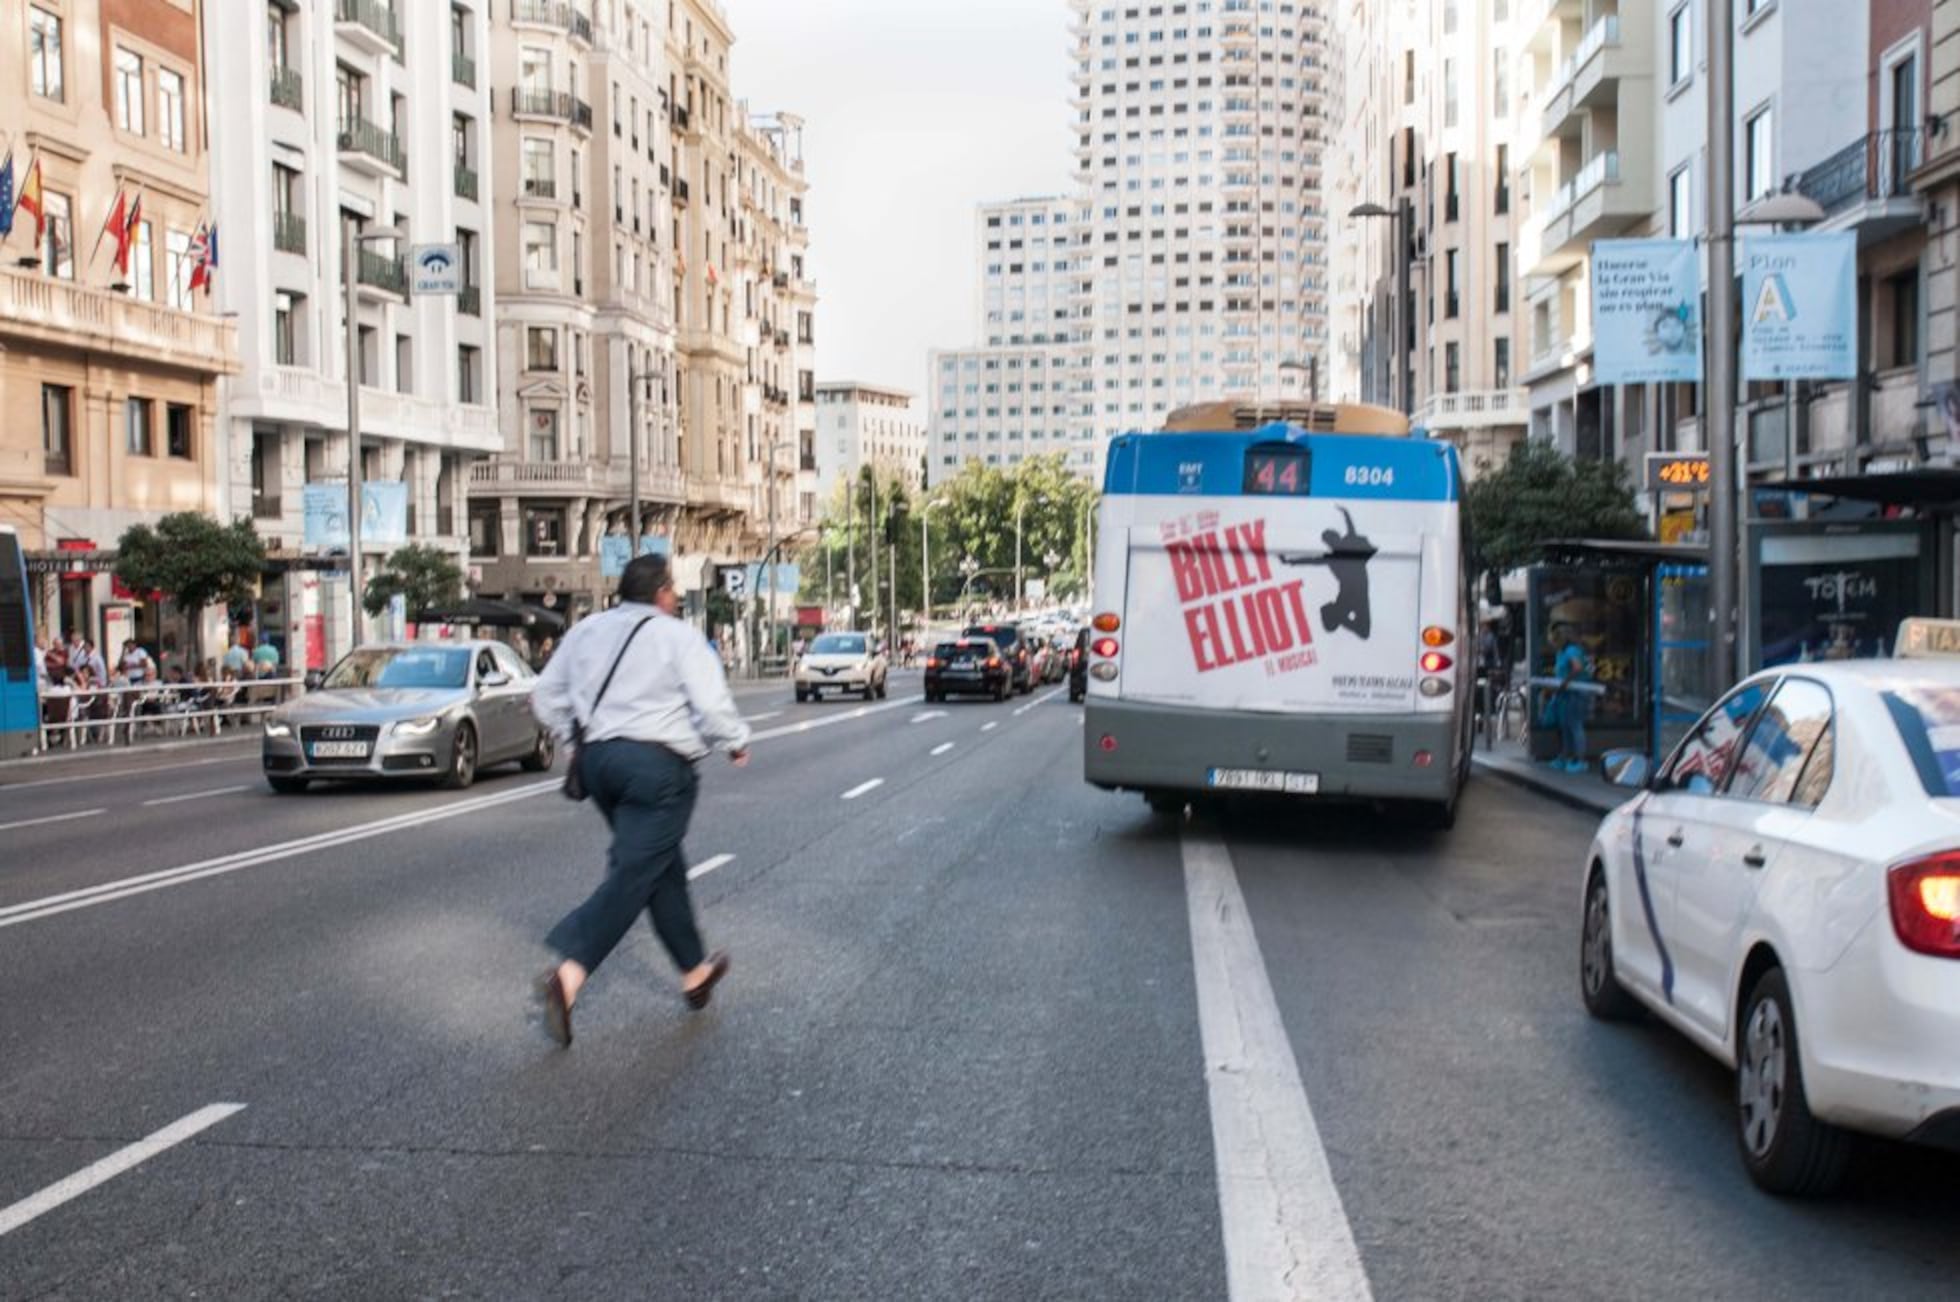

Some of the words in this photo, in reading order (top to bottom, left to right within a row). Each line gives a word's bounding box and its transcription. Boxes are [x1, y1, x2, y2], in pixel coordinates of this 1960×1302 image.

[1751, 255, 1797, 270] Plan
[1750, 271, 1797, 322] A
[1178, 463, 1202, 475] EMT
[1257, 459, 1297, 491] 44
[1166, 519, 1272, 603] BILLY
[1184, 578, 1313, 672] ELLIOT
